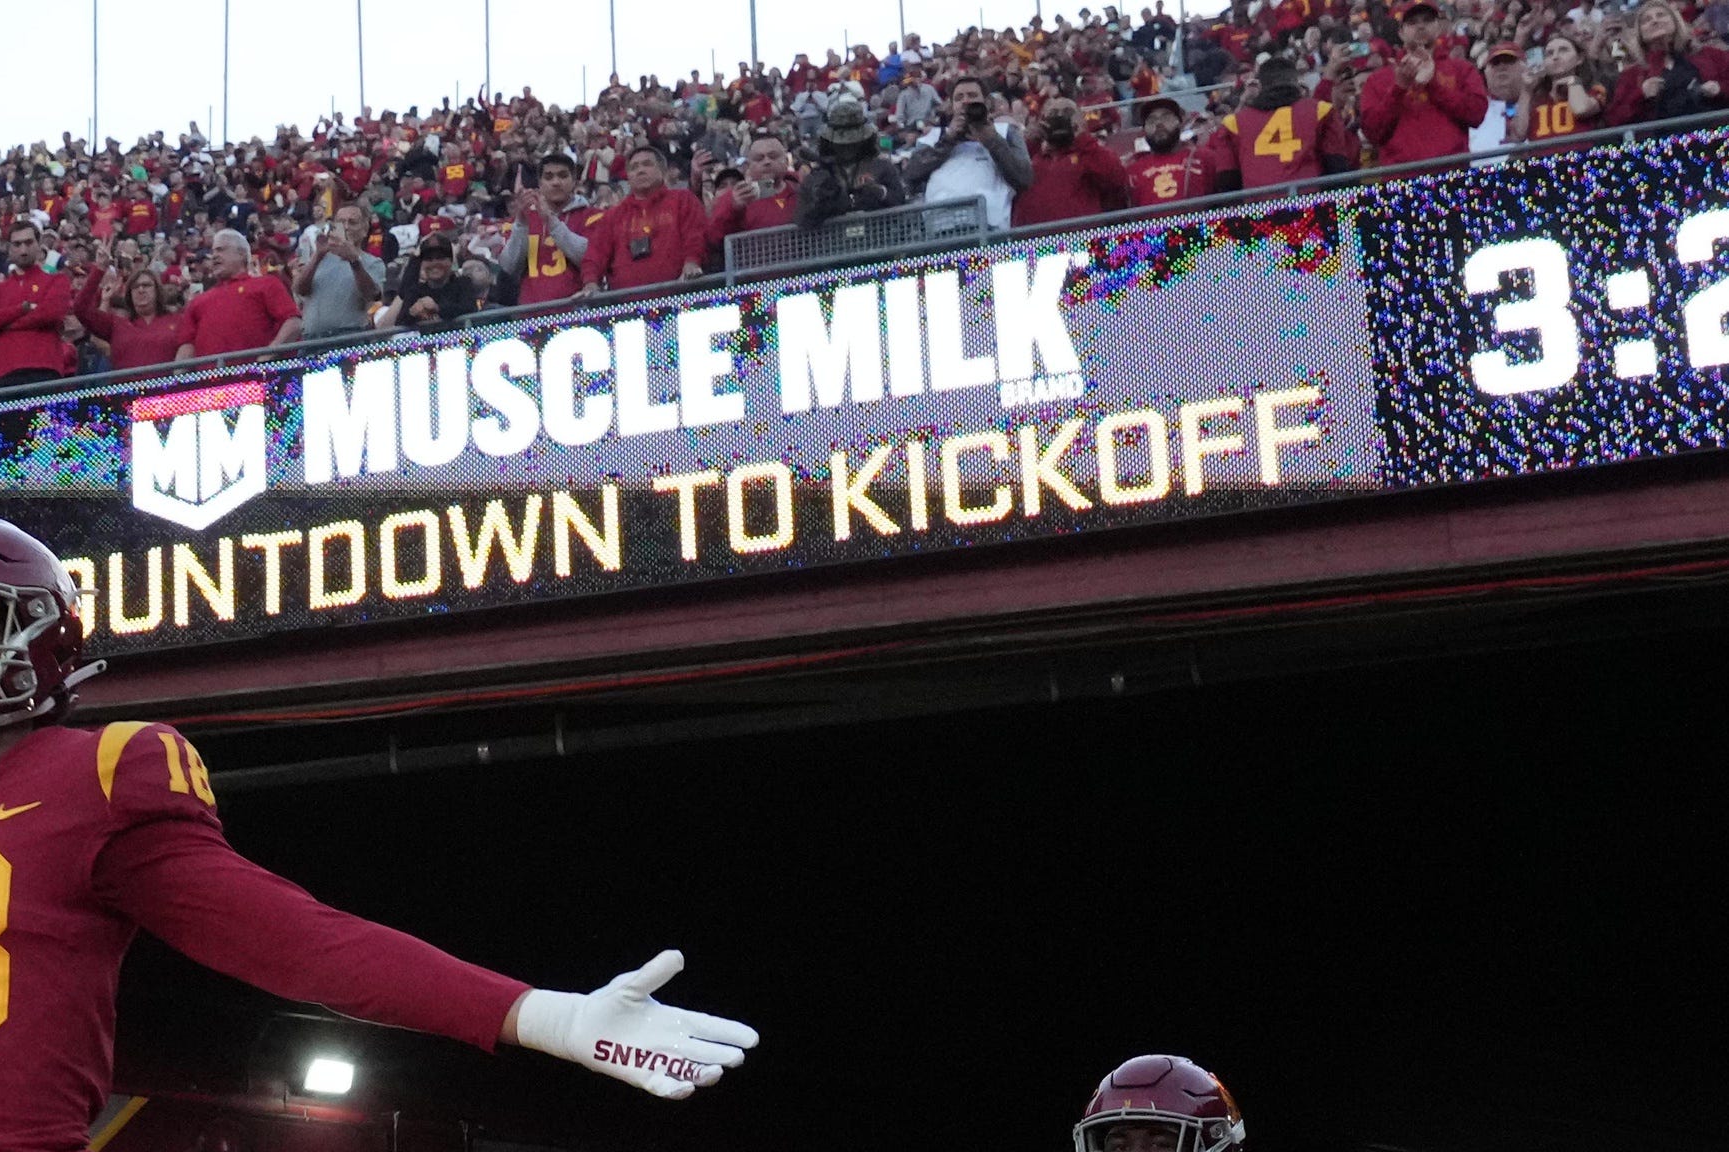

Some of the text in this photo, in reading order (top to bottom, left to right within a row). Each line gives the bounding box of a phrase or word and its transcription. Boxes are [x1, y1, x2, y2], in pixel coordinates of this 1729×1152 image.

[1254, 107, 1302, 163] 4
[527, 234, 567, 278] 13
[302, 252, 1089, 485] MUSCLE MILK
[61, 385, 1321, 640] OUNTDOWN TO KICKOFF
[158, 732, 216, 808] 18
